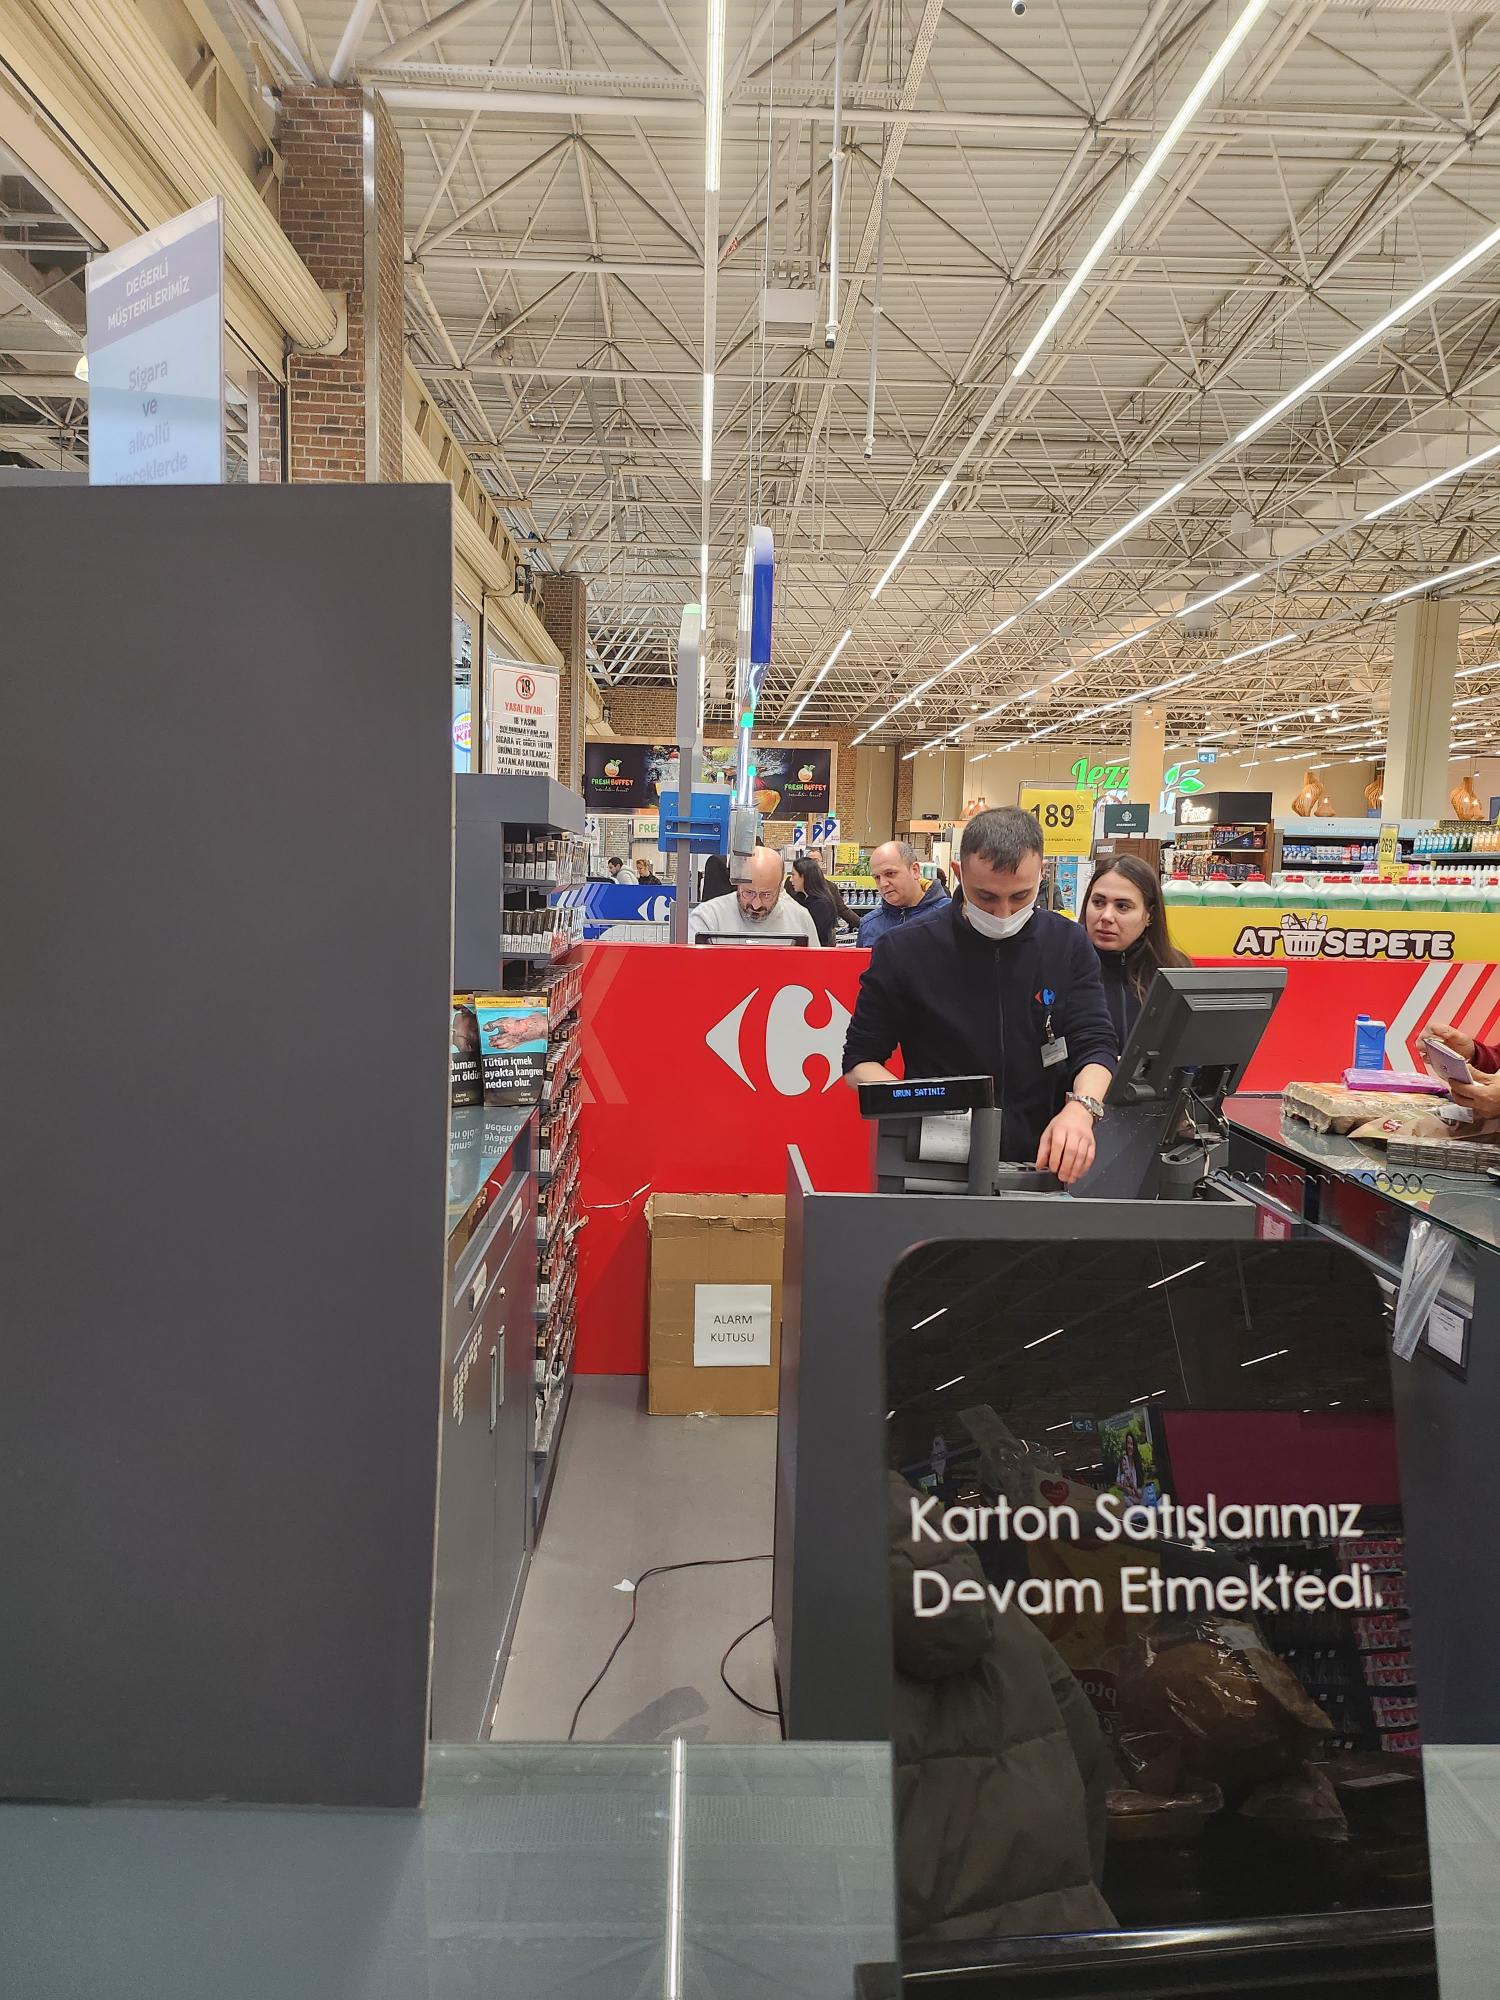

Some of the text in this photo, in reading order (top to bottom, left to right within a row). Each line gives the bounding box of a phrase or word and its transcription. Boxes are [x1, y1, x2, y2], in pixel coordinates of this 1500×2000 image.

[125, 257, 169, 297] DEĞERLİ
[107, 275, 190, 331] MÜŞTERİLERİMİZ
[128, 360, 168, 392] Sigara
[142, 398, 158, 417] ve
[128, 421, 170, 455] alkollü
[504, 702, 543, 716] YASAL UYARI
[497, 756, 527, 766] SATANLAR
[591, 778, 610, 786] FRESH
[784, 783, 804, 791] FRESH
[1030, 803, 1075, 828] 189
[638, 823, 659, 833] FRE
[1235, 927, 1454, 959] AT SEPETE
[483, 1056, 533, 1070] Tütün içmek
[484, 1066, 514, 1079] ayakta
[485, 1078, 531, 1089] neden olur.
[892, 1087, 946, 1098] URUN SATINIZ
[713, 1314, 753, 1325] ALARM
[710, 1332, 755, 1343] KUTUSU
[908, 1492, 1365, 1552] Karton Satışlarımız
[911, 1569, 1104, 1619] Devam
